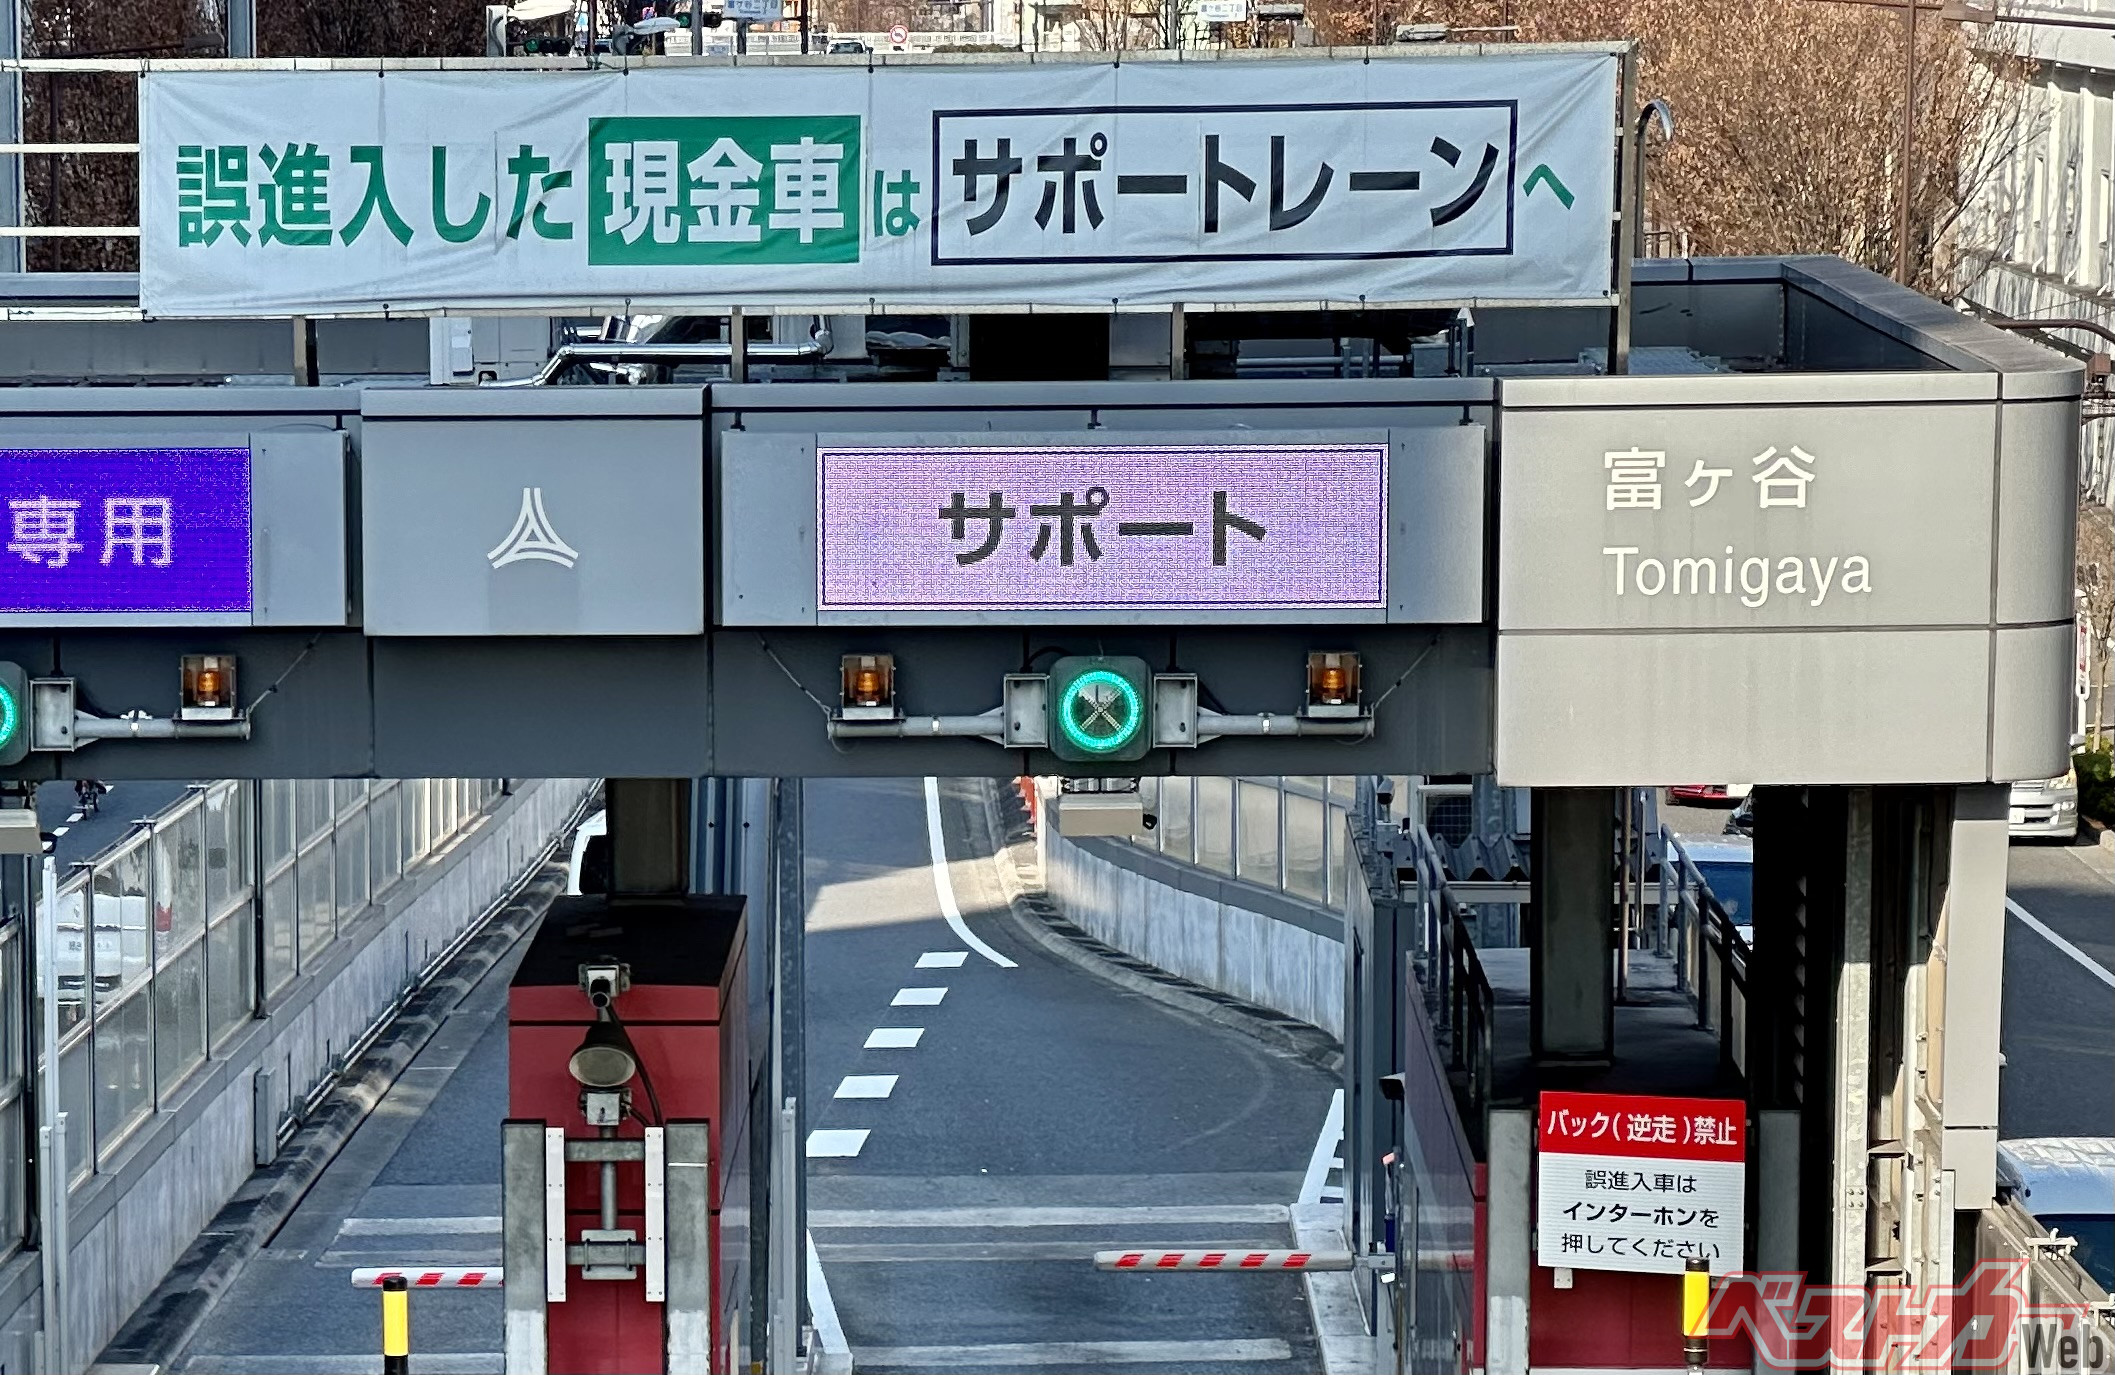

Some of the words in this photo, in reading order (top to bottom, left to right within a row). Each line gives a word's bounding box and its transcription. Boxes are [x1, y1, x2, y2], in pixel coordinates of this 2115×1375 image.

[177, 142, 574, 248] 誤進入した
[604, 137, 845, 244] 現金車
[874, 169, 921, 237] は
[952, 132, 1499, 236] サポートレーン
[1604, 445, 1816, 511] 富ヶ谷
[7, 495, 173, 568] 専用
[938, 486, 1267, 567] サポート
[1602, 545, 1873, 608] Tomigaya
[1585, 1169, 1698, 1193] 誤進入車は
[1561, 1232, 1720, 1260] 押してください
[1562, 1201, 1720, 1229] インターホンを
